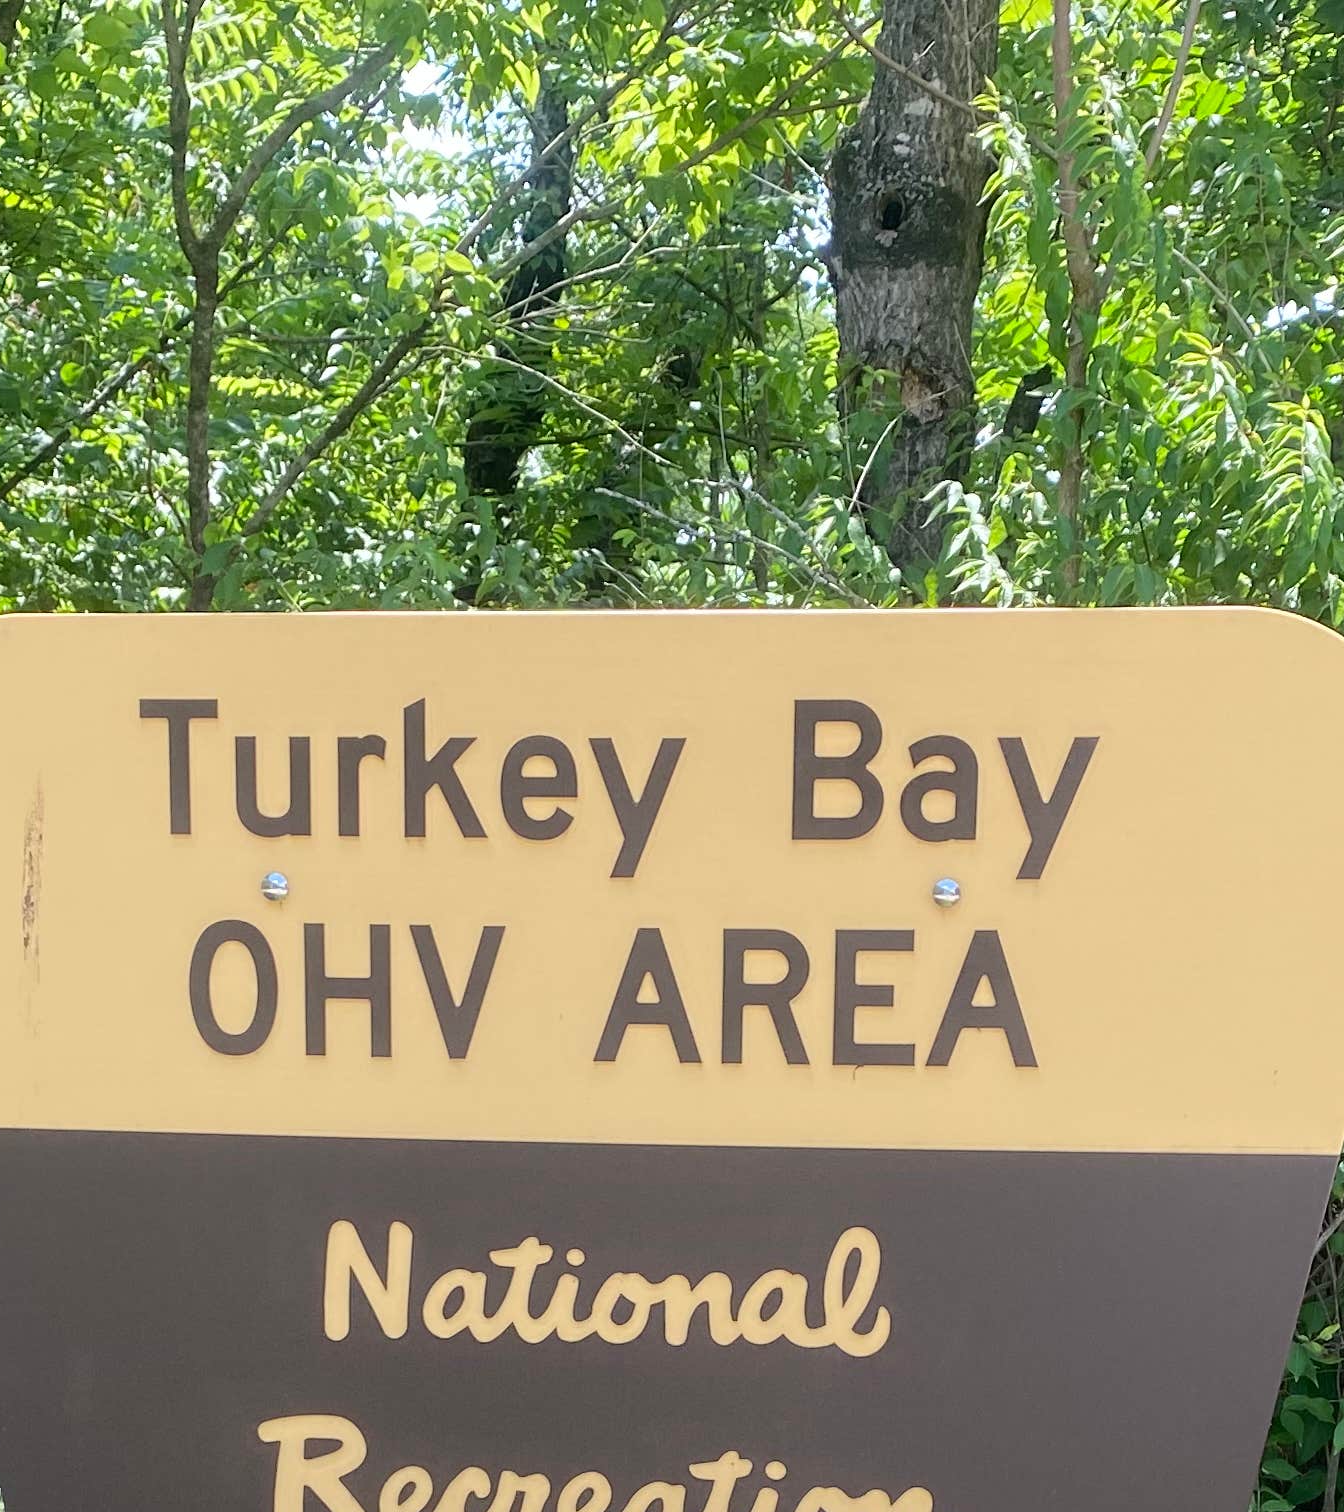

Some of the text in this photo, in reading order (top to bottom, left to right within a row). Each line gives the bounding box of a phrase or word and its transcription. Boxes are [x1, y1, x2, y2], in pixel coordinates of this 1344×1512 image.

[139, 698, 1099, 880] Turkey Bay
[187, 920, 1040, 1070] OHV AREA
[321, 1220, 891, 1357] National
